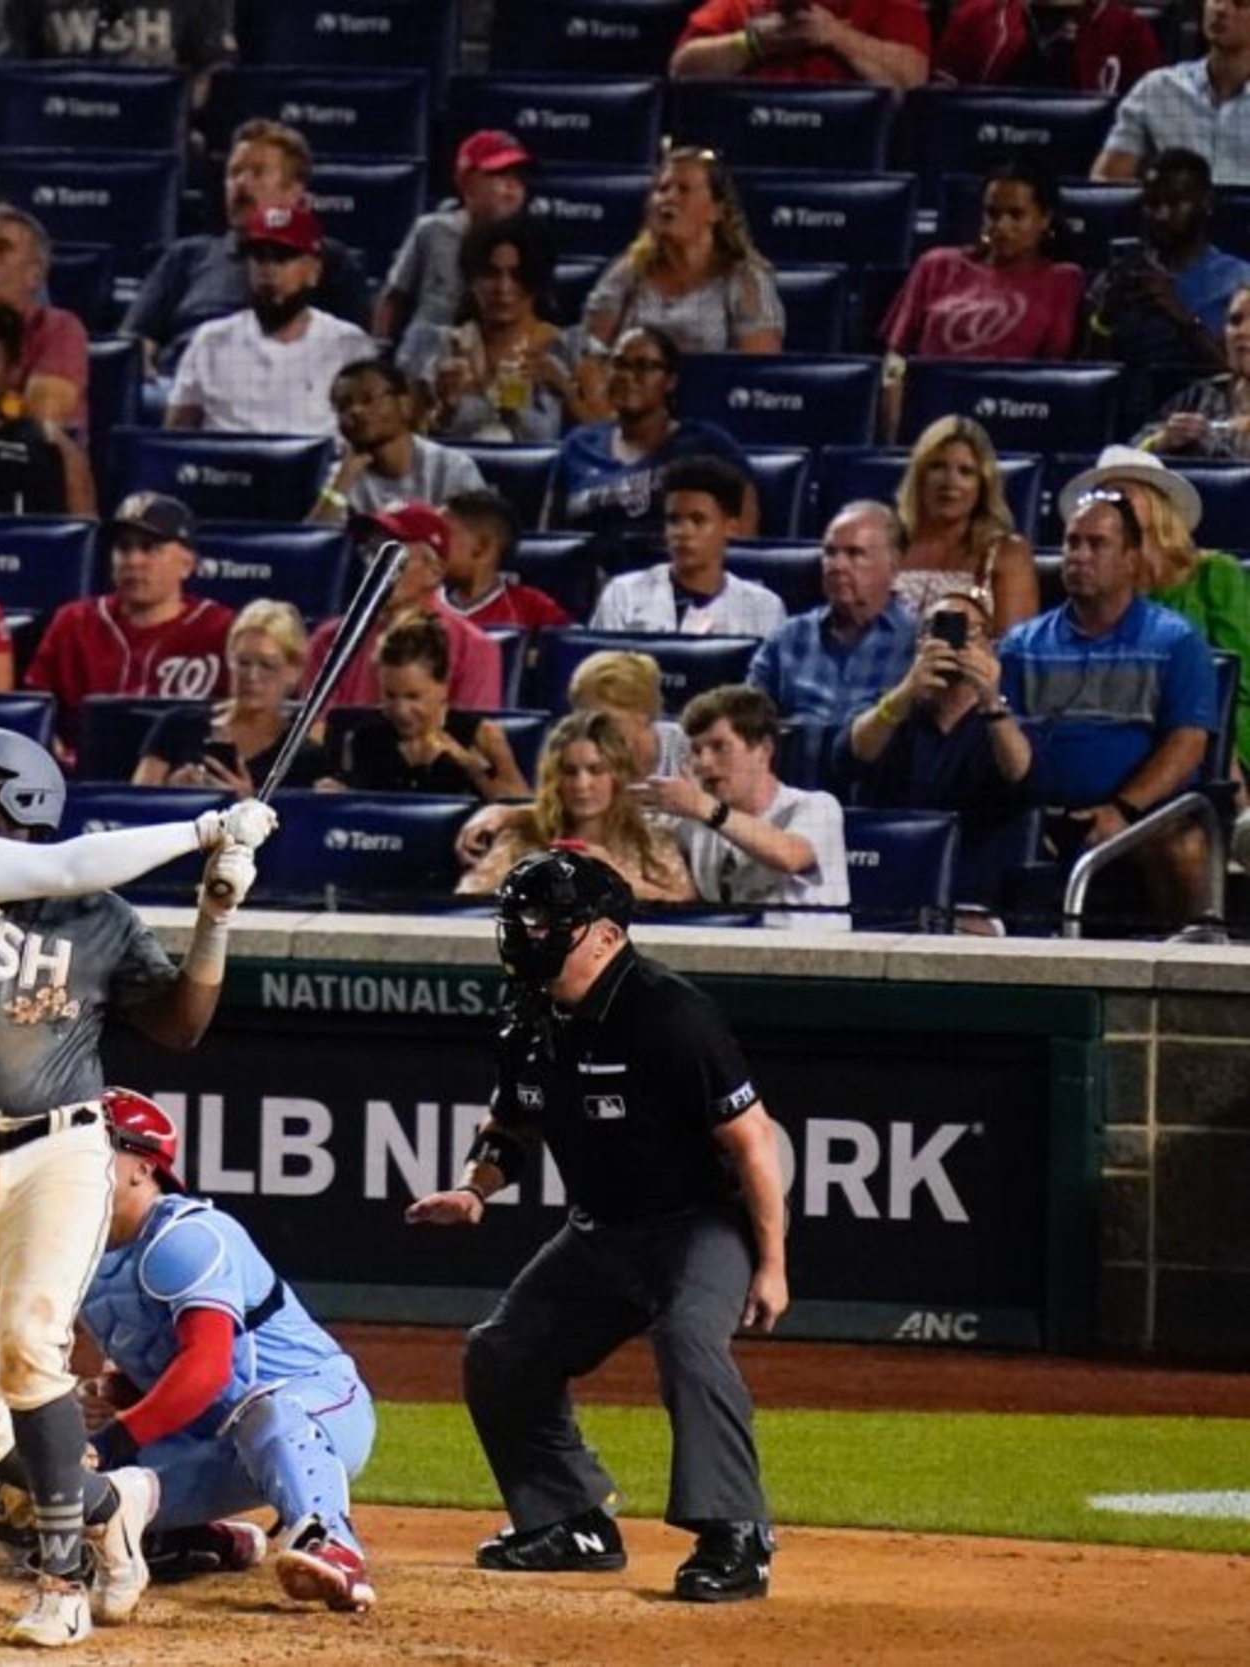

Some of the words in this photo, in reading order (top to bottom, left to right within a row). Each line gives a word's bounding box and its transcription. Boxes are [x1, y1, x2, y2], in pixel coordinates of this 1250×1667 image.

[340, 16, 390, 32] Terra
[590, 21, 638, 38] Terra
[69, 100, 120, 117] Terra
[305, 107, 355, 123] Terra
[540, 111, 590, 129] Terra
[773, 110, 821, 127] Terra
[1000, 126, 1050, 144] Terra
[58, 188, 109, 205] Terra
[554, 202, 603, 219] Terra
[795, 210, 845, 227] Terra
[754, 390, 804, 410] Terra
[1000, 400, 1049, 417] Terra
[199, 466, 251, 487] Terra
[219, 560, 271, 579] Terra
[351, 832, 402, 851] Terra
[849, 850, 881, 867] rra
[892, 1311, 980, 1341] ANC
